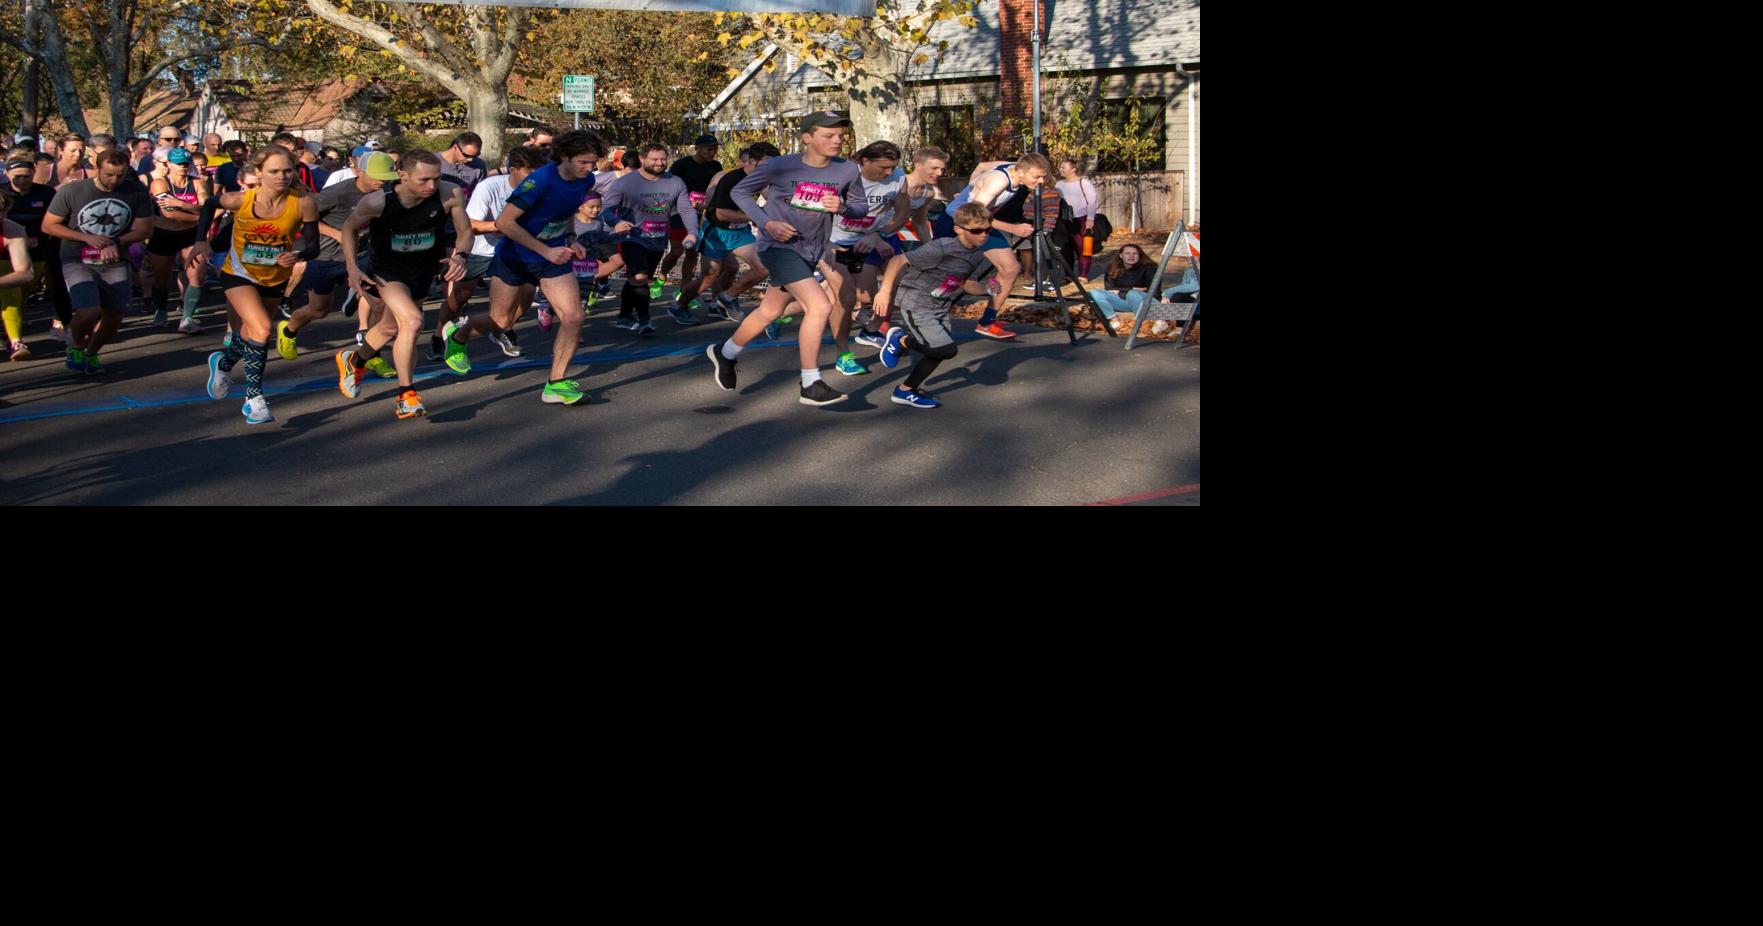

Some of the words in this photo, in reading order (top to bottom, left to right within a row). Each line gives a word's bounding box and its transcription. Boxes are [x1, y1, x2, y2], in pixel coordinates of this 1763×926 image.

[801, 185, 820, 194] TURKEY
[866, 194, 888, 204] ERS
[248, 244, 269, 252] TURKEY
[256, 251, 274, 260] 58
